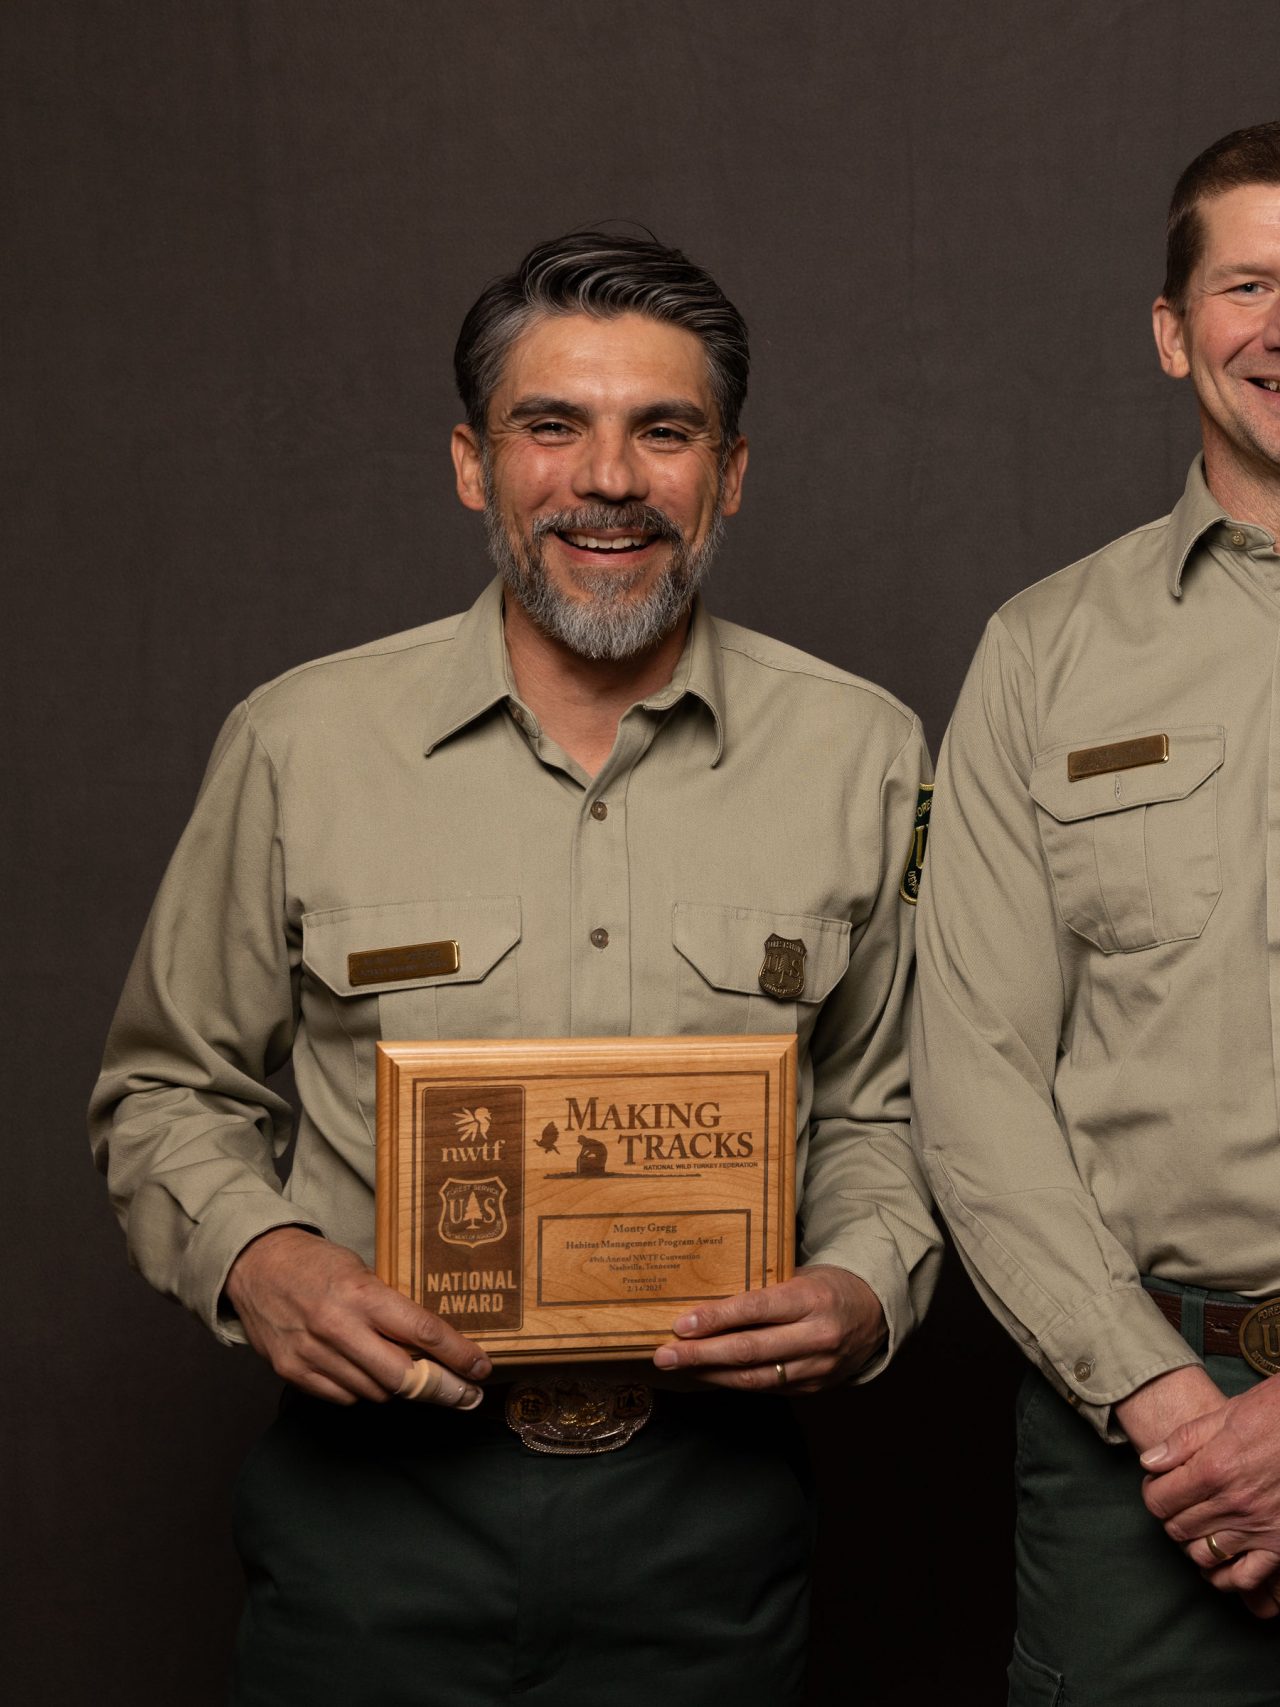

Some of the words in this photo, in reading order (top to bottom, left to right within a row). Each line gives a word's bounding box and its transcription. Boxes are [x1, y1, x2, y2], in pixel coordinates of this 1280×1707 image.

[441, 1140, 506, 1162] nwtf
[617, 1132, 754, 1165] TRACKS
[718, 1161, 758, 1169] FEDERATION
[613, 1224, 646, 1234] Monty
[647, 1223, 678, 1233] Gregg
[566, 1240, 599, 1249] Habitat
[600, 1239, 657, 1249] Management
[658, 1238, 695, 1248] Program
[696, 1236, 723, 1246] Award
[646, 1262, 681, 1270] Tennessee
[427, 1270, 517, 1292] NATIONAL
[438, 1293, 504, 1314] AWARD
